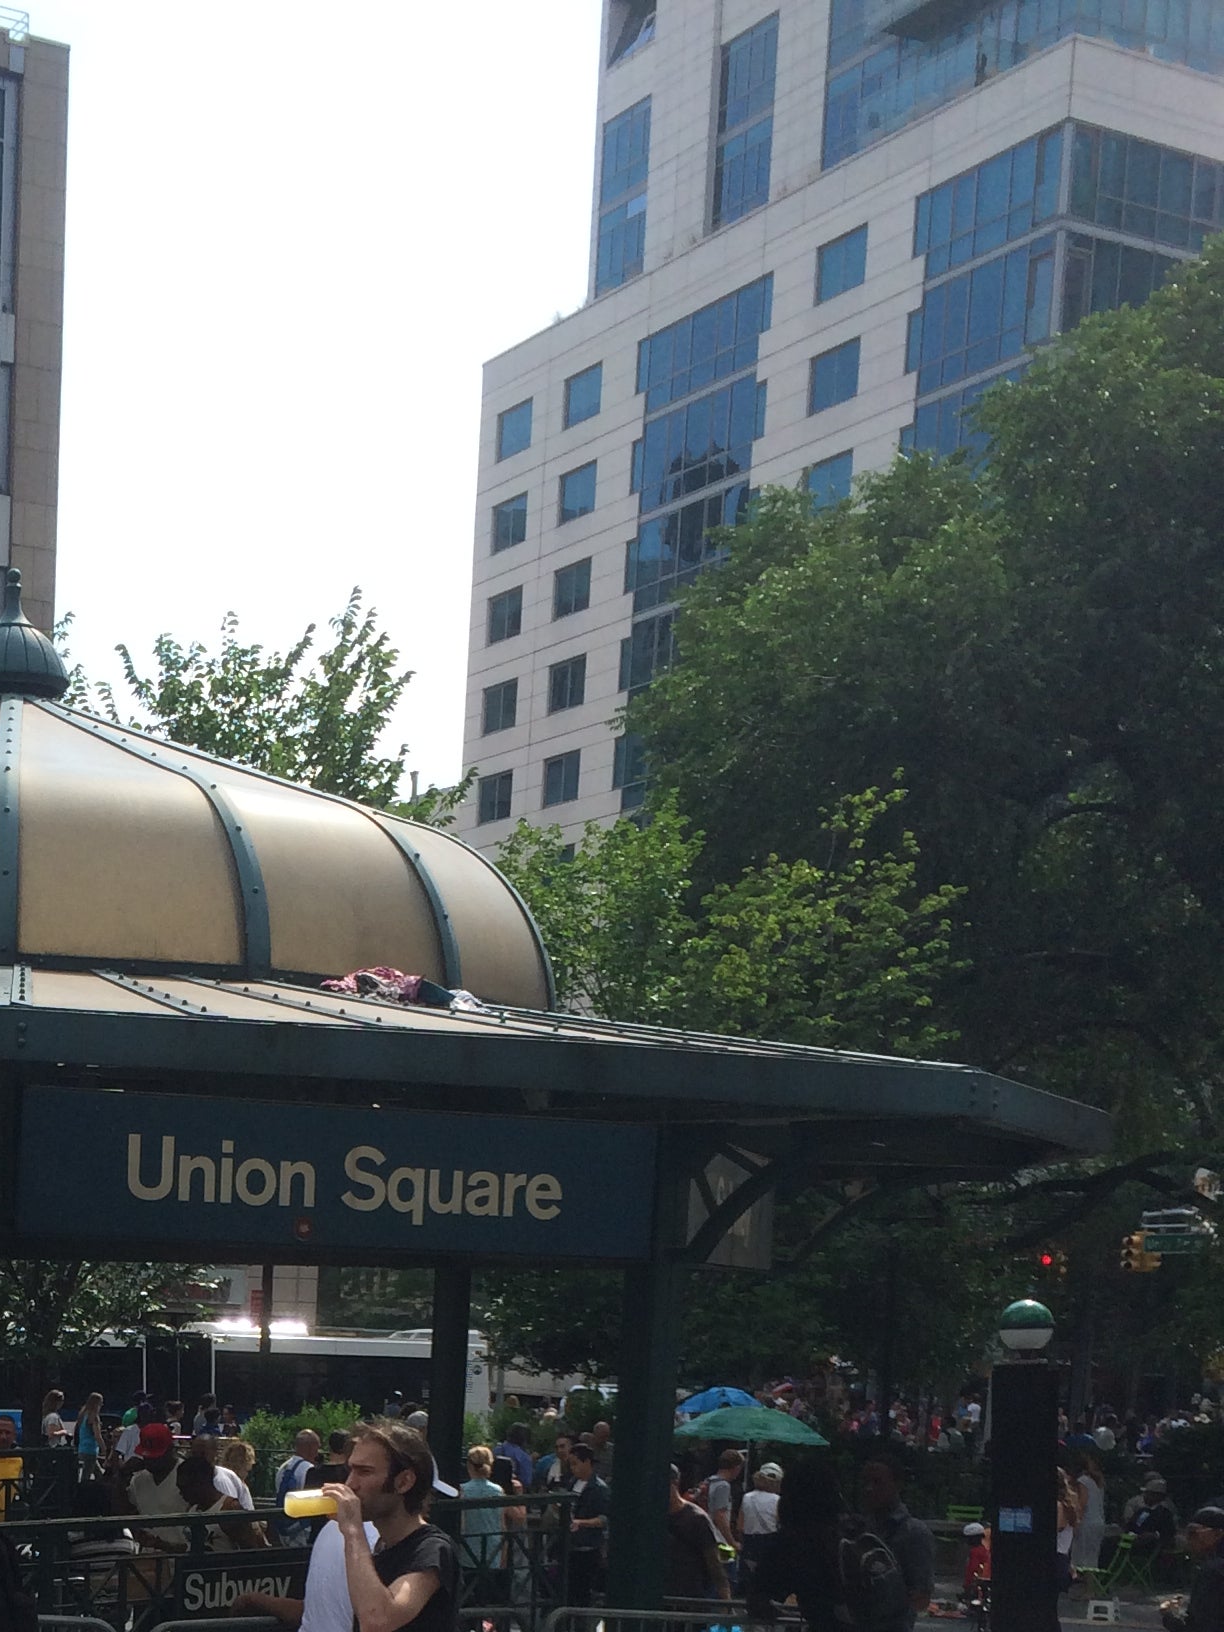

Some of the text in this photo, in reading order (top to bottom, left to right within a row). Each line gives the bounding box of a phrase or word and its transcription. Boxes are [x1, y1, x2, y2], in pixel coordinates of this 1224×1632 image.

[126, 1132, 563, 1226] Union Square
[183, 1571, 292, 1612] Subway
